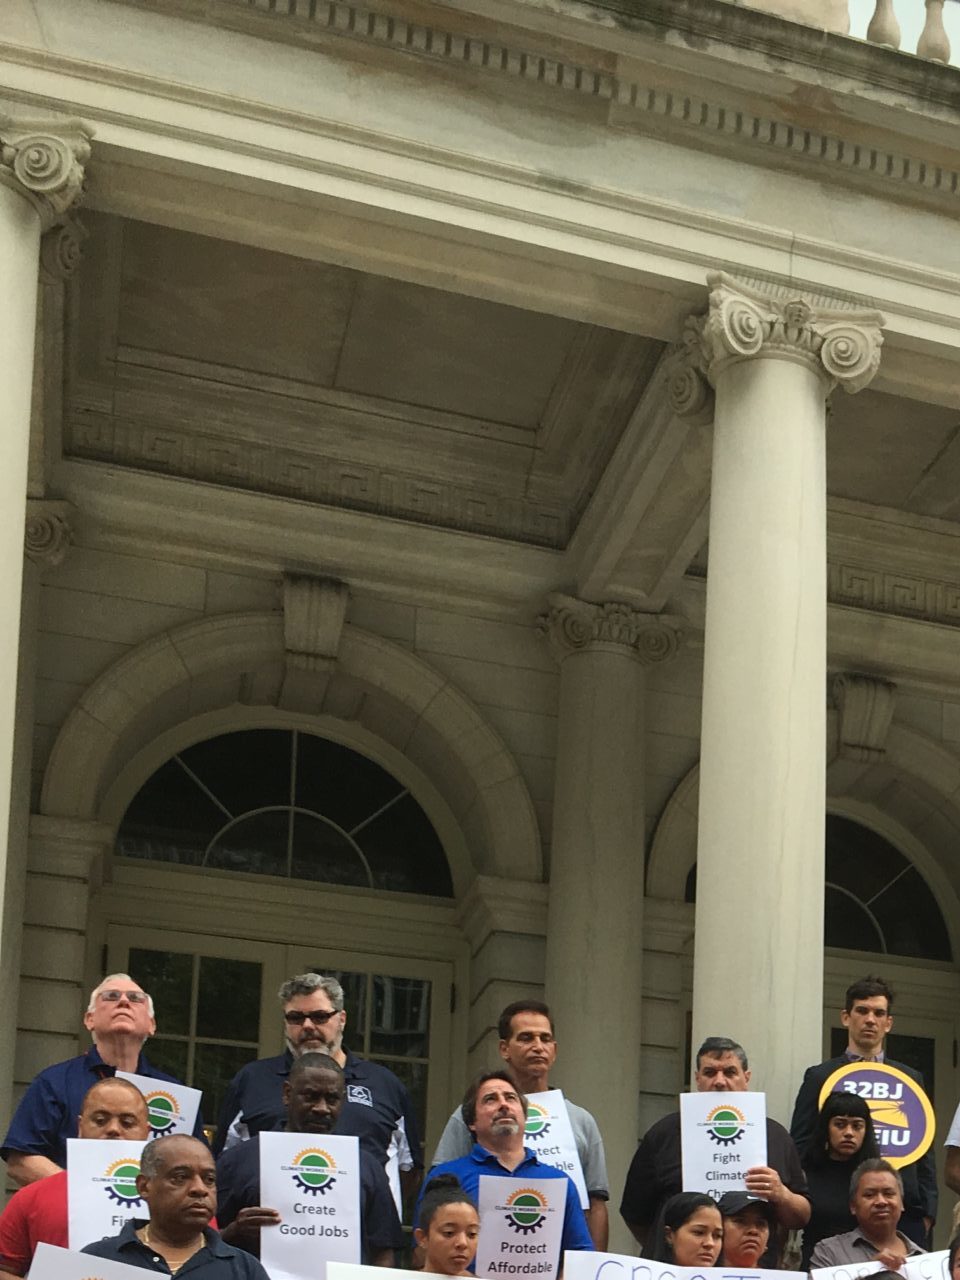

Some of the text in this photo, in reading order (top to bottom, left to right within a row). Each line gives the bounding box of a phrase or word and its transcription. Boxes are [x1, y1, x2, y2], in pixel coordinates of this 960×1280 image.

[843, 1080, 903, 1100] 32BJ
[536, 1146, 561, 1156] tect
[713, 1152, 741, 1164] Fight
[705, 1171, 748, 1181] Climate
[293, 1203, 336, 1216] Create
[280, 1224, 349, 1238] Good Jobs
[500, 1242, 547, 1254] Protect
[487, 1261, 552, 1274] Affordable
